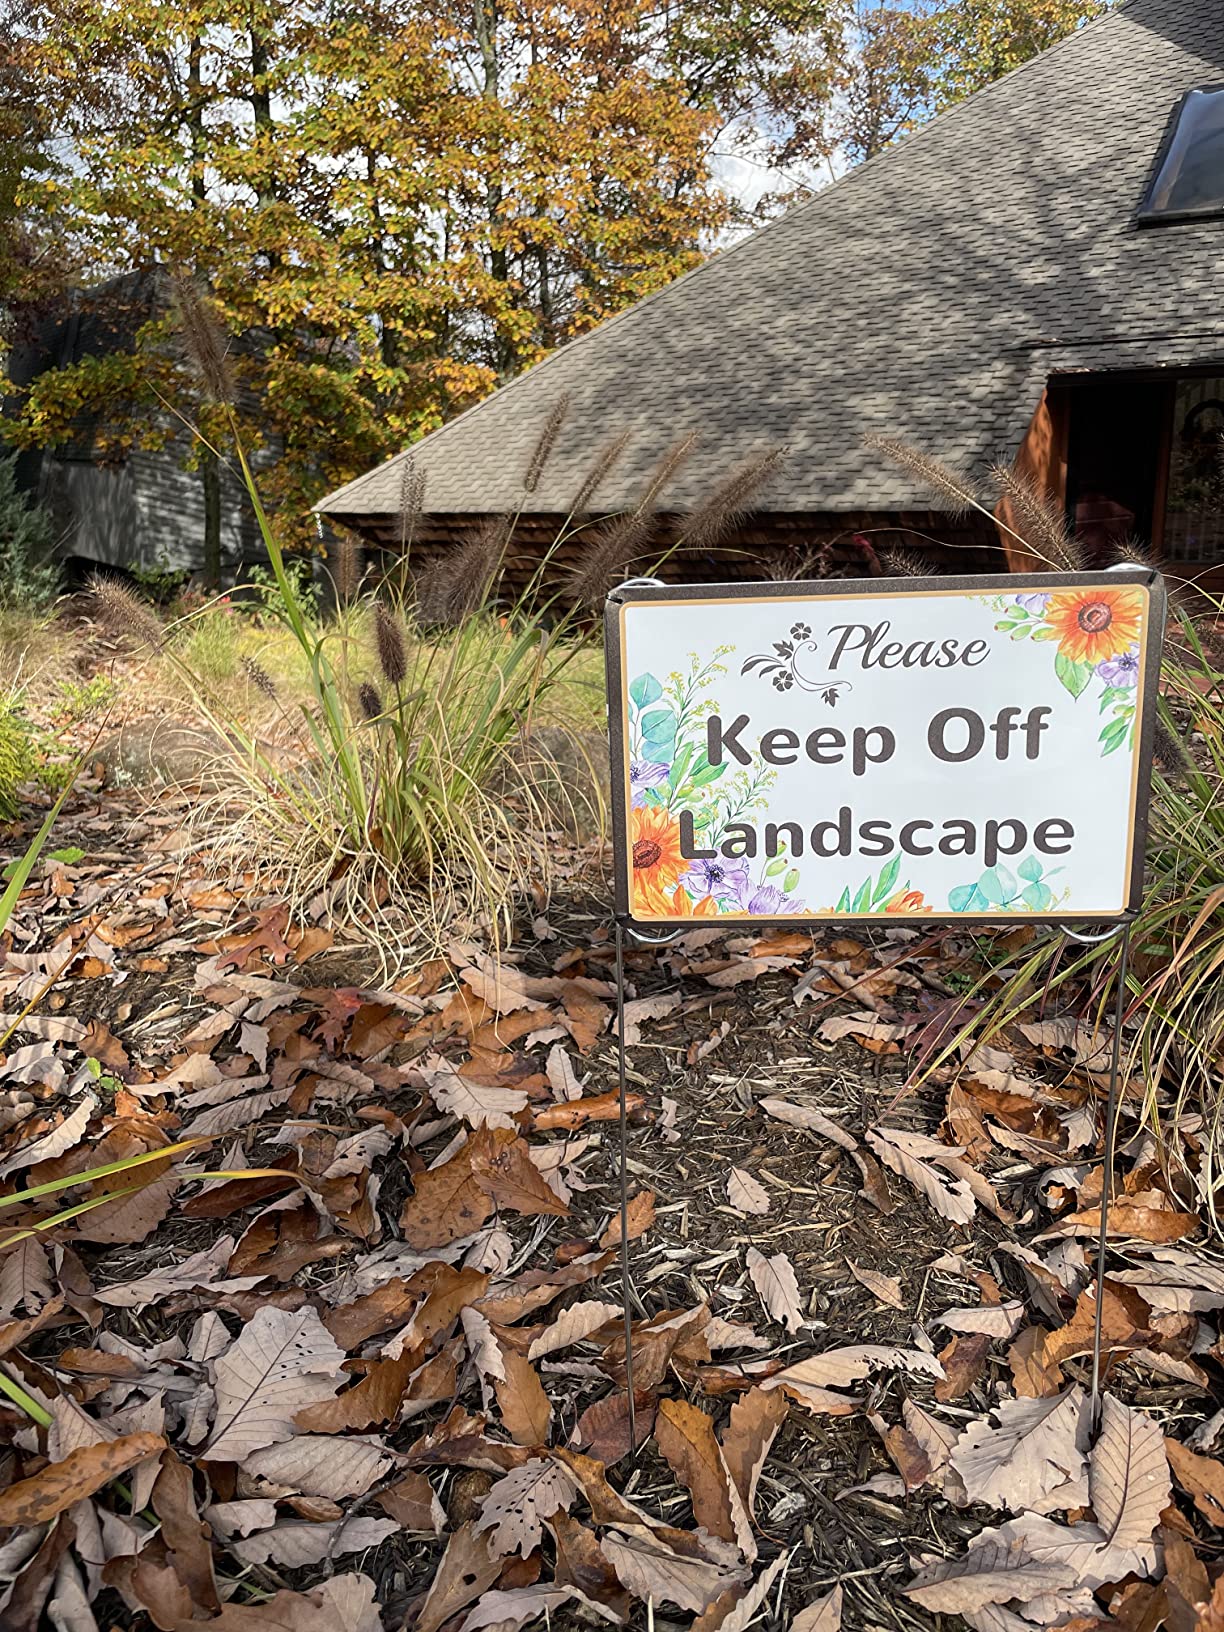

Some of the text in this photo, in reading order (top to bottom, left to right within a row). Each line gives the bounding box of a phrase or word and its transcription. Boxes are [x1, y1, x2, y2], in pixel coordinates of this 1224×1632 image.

[827, 620, 990, 671] Please
[706, 706, 1053, 776] Keep Off
[679, 806, 1075, 867] Landscape
